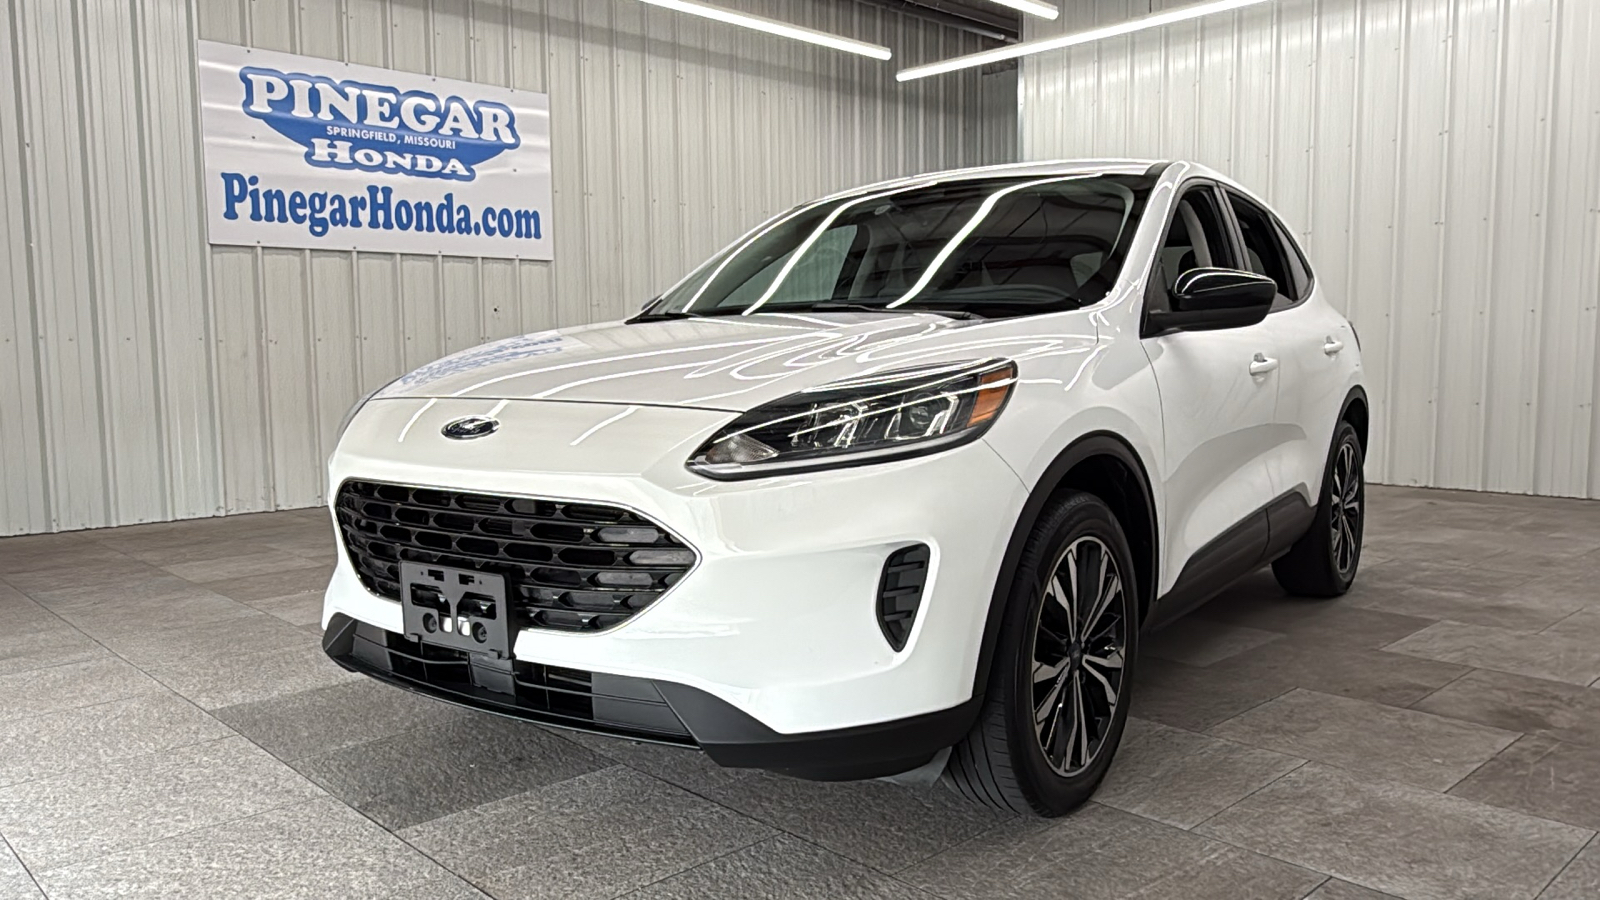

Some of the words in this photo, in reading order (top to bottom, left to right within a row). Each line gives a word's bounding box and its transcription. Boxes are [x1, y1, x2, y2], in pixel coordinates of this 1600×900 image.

[246, 73, 516, 144] PINEGAR
[311, 138, 471, 176] HONDA
[326, 125, 401, 145] SPRINGFIELD,
[404, 135, 456, 150] MISSOURI
[221, 172, 542, 240] PinegarHonda.com
